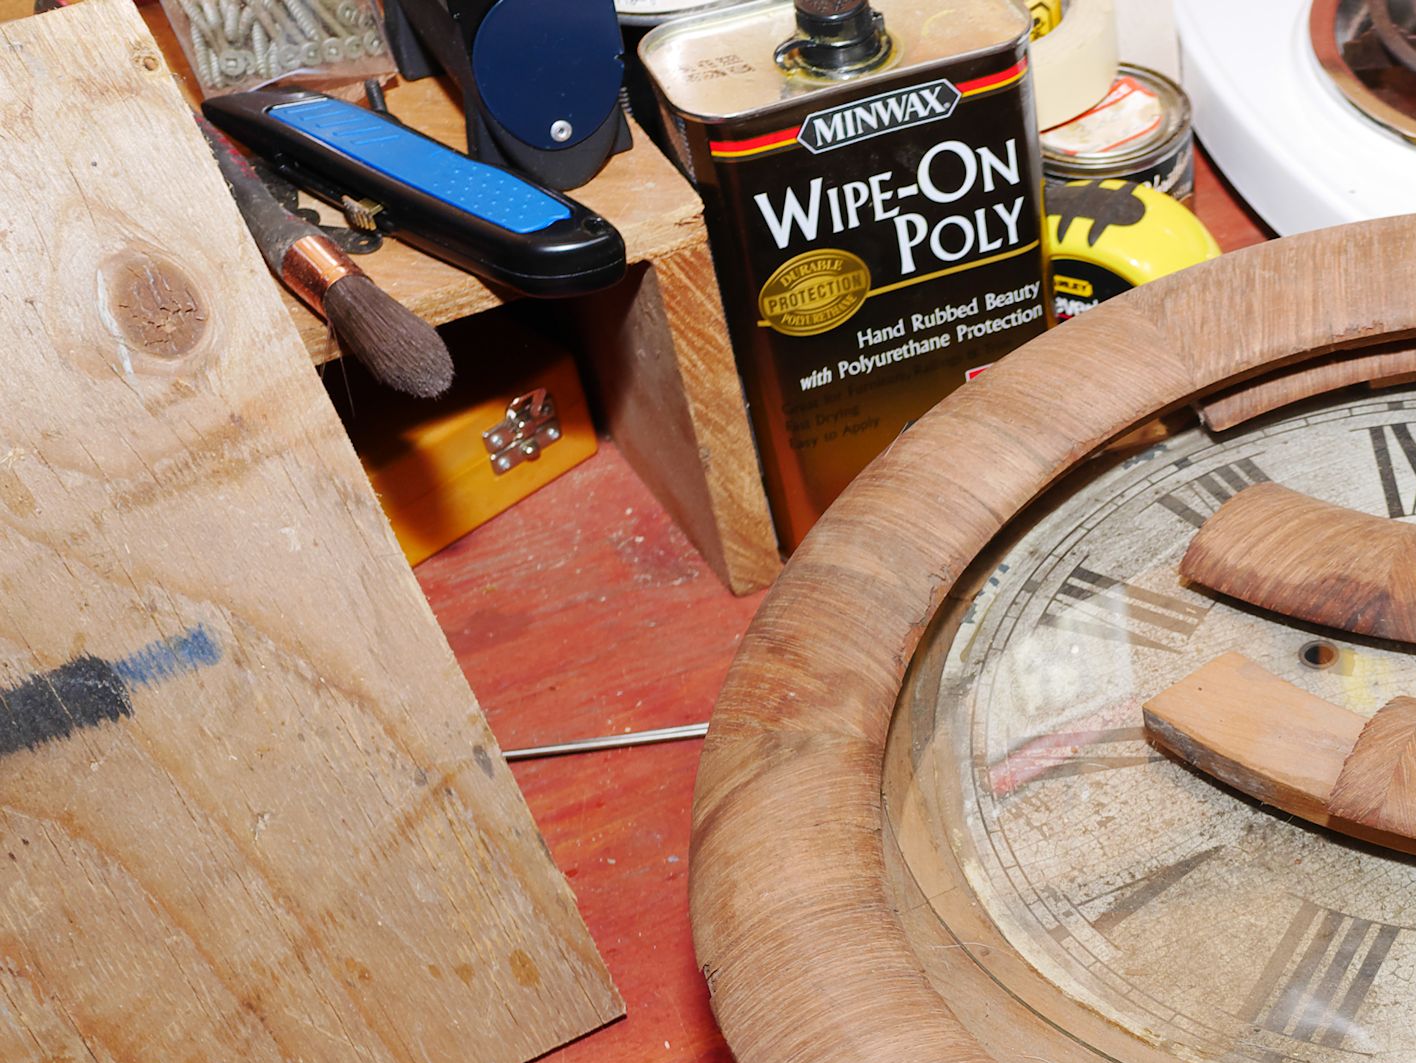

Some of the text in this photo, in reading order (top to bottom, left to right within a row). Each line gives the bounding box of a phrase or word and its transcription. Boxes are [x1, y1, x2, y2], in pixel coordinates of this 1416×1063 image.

[812, 86, 943, 147] MINWAX
[754, 139, 1020, 250] WIPE-ON
[894, 197, 1024, 275] POLY
[767, 271, 863, 314] PROTECTION
[780, 258, 844, 287] DURABLE
[781, 293, 858, 326] POLYURETHANE
[857, 319, 905, 349] Hand
[911, 298, 979, 332] Rubbed
[985, 281, 1041, 310] Beauty
[799, 366, 832, 391] with
[838, 332, 951, 379] Polyurethane
[956, 304, 1043, 343] Protection
